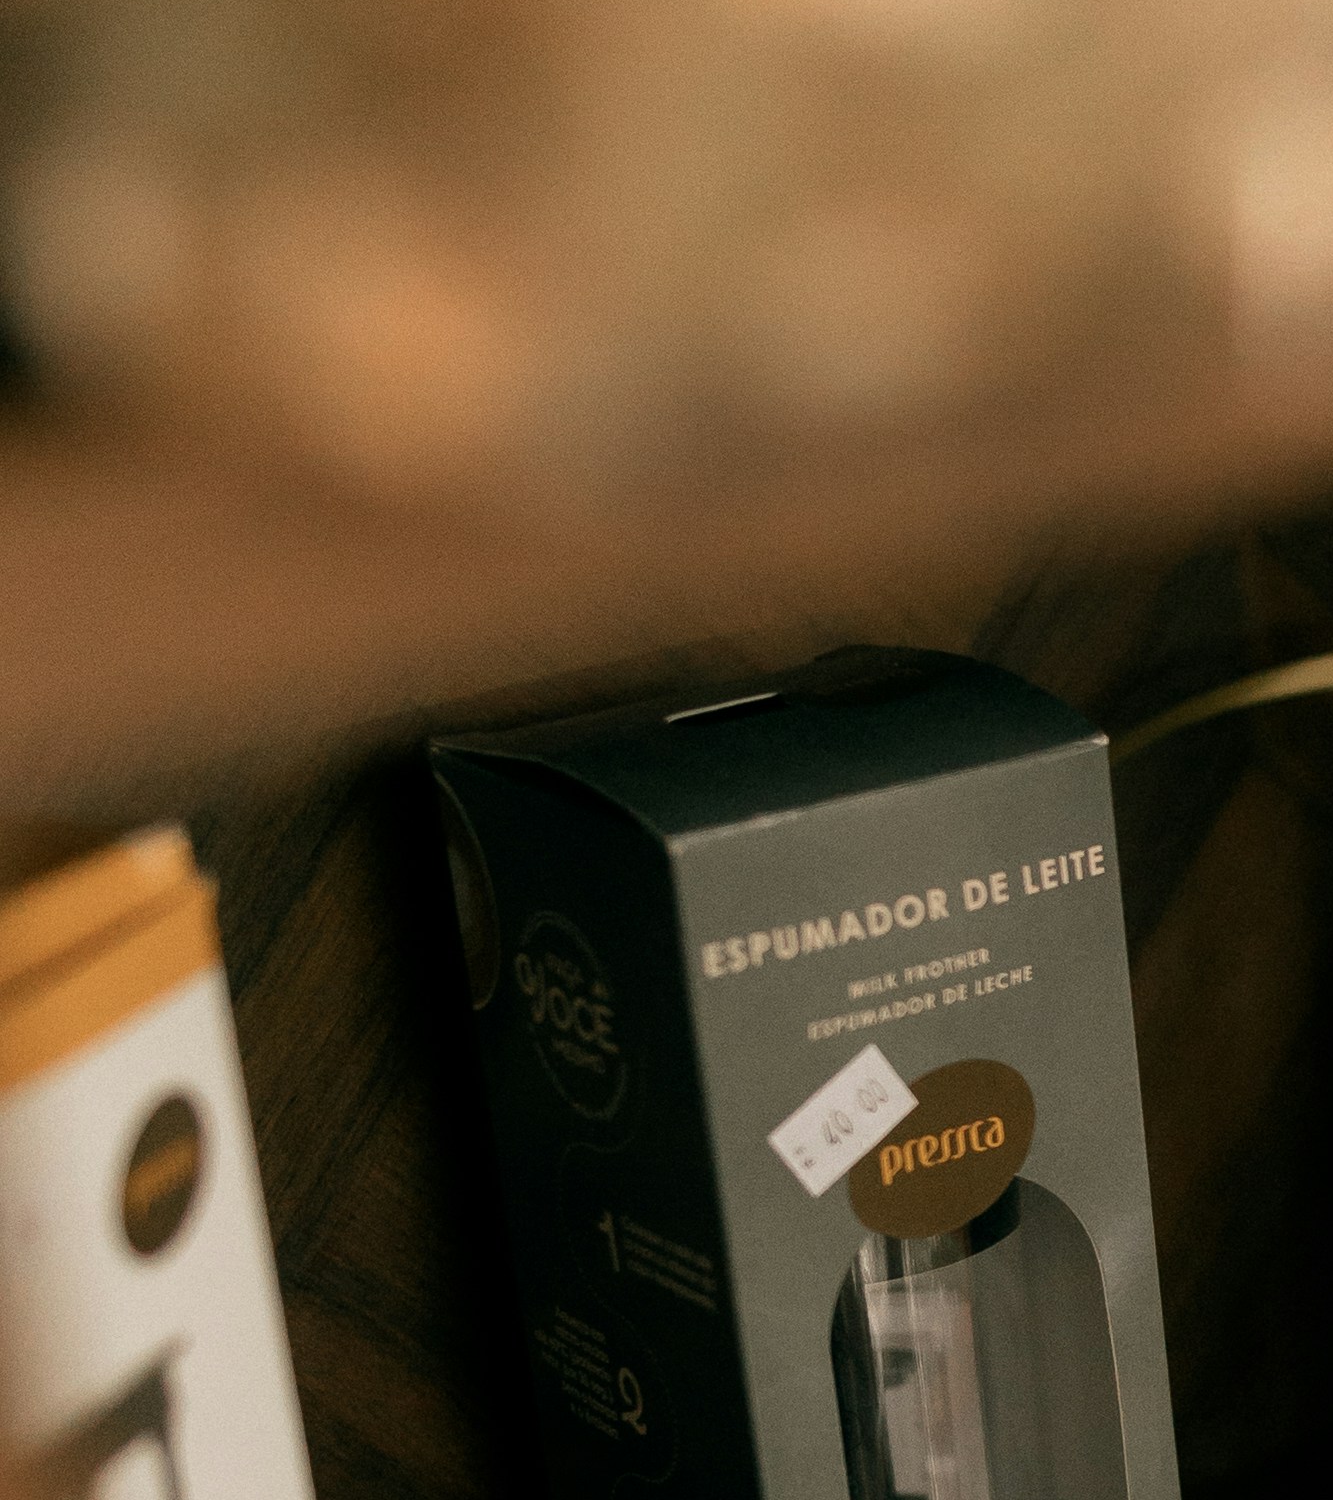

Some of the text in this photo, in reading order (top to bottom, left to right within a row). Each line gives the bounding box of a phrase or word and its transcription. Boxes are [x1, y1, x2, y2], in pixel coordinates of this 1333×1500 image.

[701, 844, 1106, 979] ESPUMADOR DE LEITE
[806, 964, 1034, 1042] ESPUMADOR DE LECHE
[847, 946, 991, 1000] MILK FROTHER
[879, 1114, 1007, 1187] pressca
